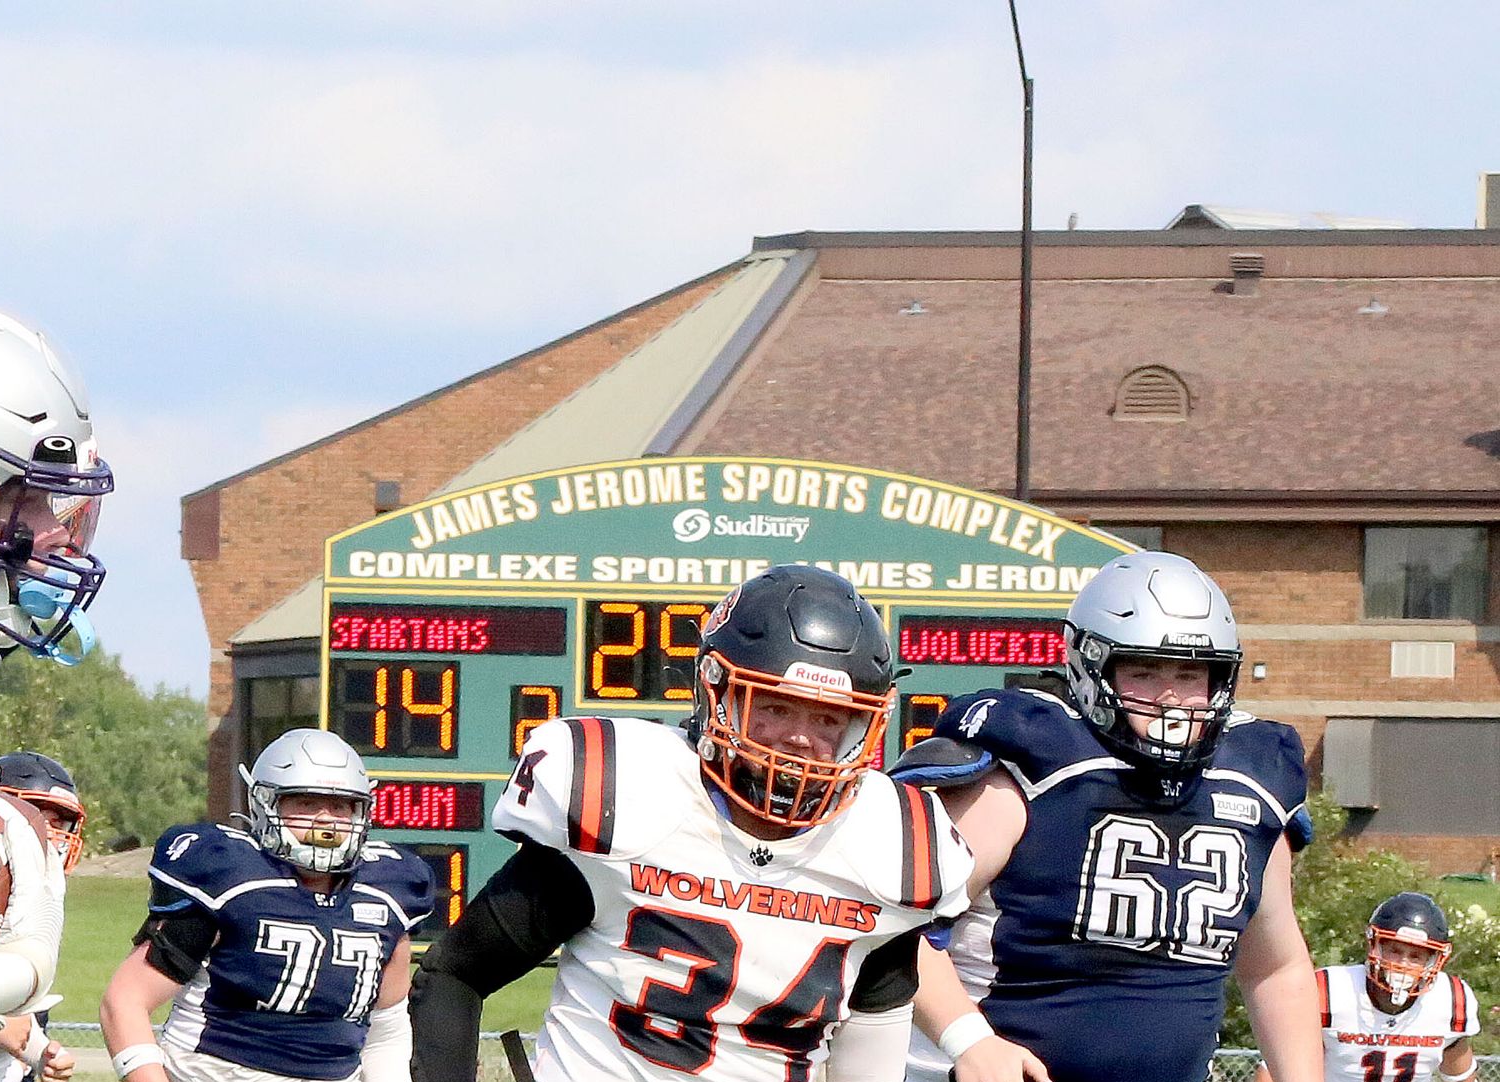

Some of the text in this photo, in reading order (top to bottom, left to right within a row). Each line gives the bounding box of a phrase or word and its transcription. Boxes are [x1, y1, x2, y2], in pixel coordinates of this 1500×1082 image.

[410, 463, 1067, 562] JAMES JEROME SPORTS COMPLEX
[714, 514, 810, 544] Sudbury
[349, 550, 578, 581] COMPLEXE
[805, 560, 932, 589] AMES
[331, 616, 490, 652] SPARTANS
[796, 667, 846, 687] Riddell
[373, 667, 454, 752] 14
[630, 863, 881, 933] WOLVERINES
[1072, 813, 1249, 966] 62
[254, 919, 384, 1024] 77
[1337, 1031, 1444, 1047] WOLVERINES
